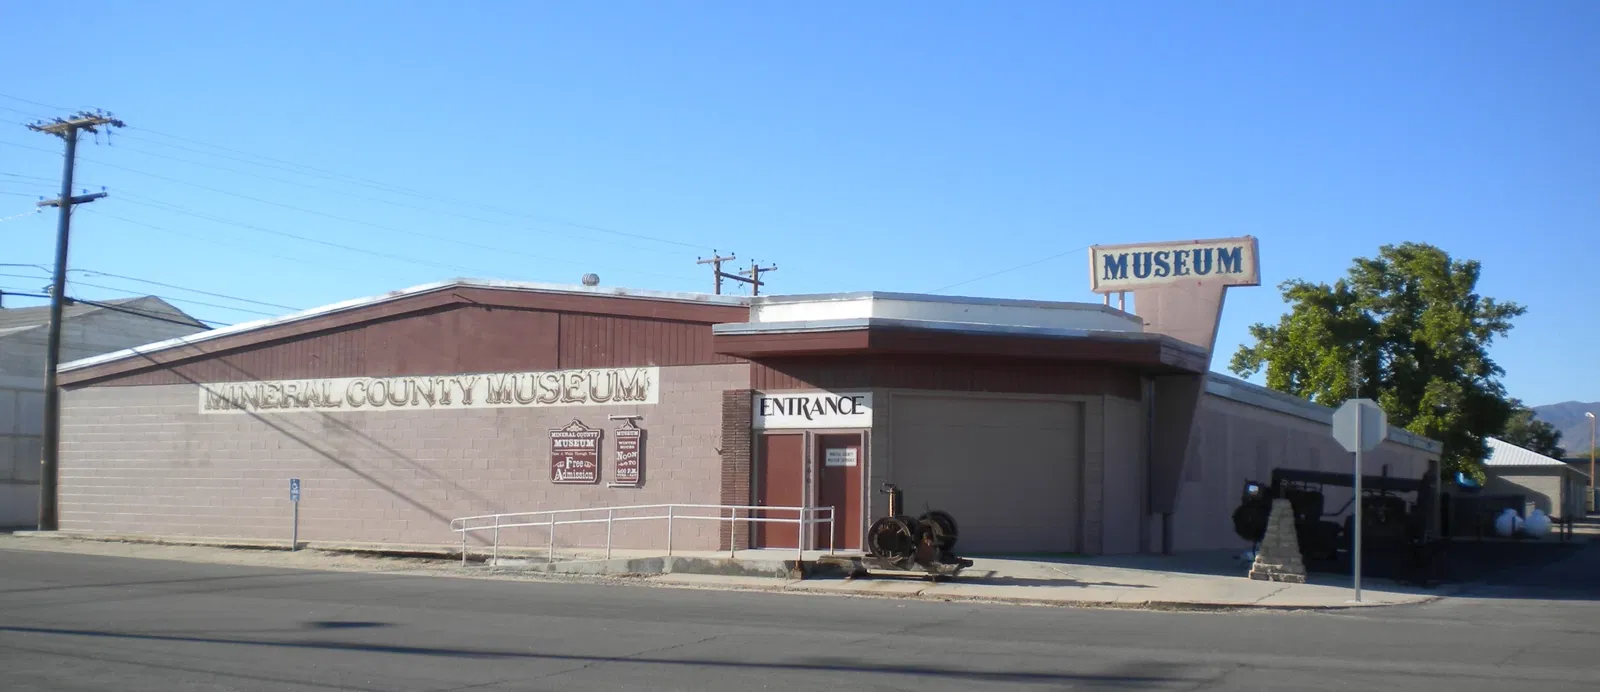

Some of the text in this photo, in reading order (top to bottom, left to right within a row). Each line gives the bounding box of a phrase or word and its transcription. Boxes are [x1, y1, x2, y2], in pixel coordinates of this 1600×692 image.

[1102, 246, 1243, 280] MUSEUM
[204, 367, 648, 411] MINERAL COUNTY MUSEUM
[760, 396, 864, 420] ENTRANCE
[553, 439, 594, 447] MUSEUM
[565, 456, 584, 469] Free
[554, 468, 593, 480] Admission
